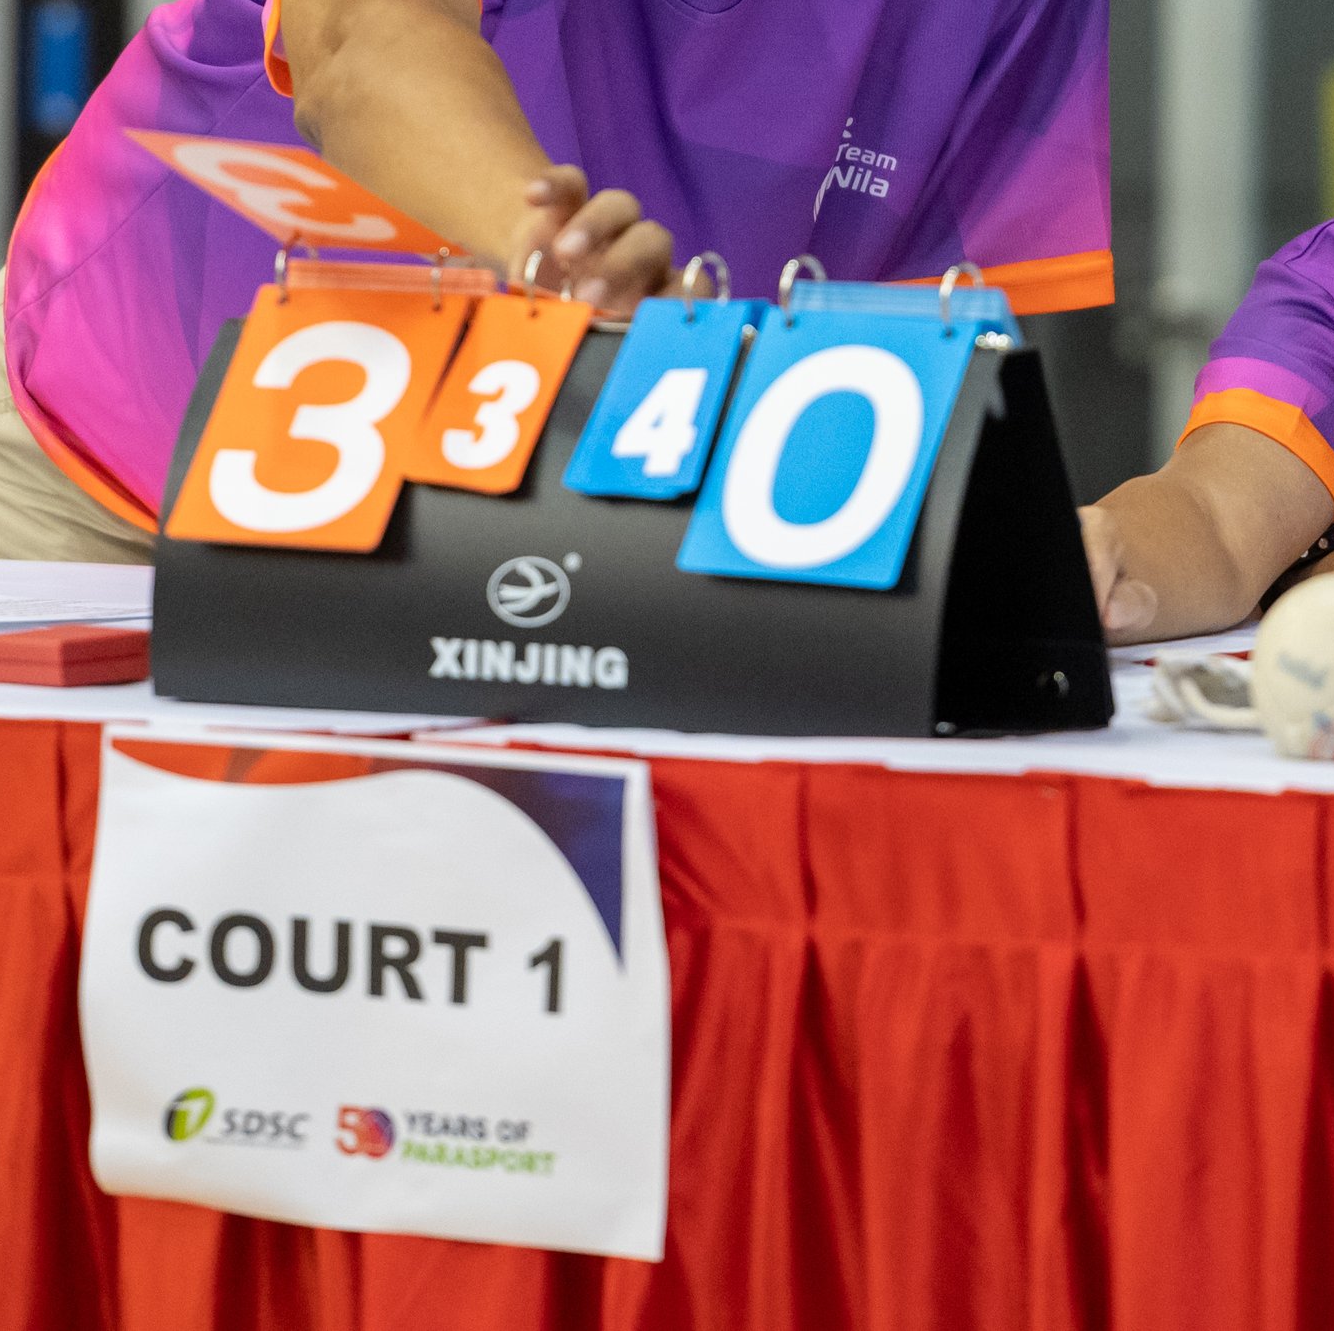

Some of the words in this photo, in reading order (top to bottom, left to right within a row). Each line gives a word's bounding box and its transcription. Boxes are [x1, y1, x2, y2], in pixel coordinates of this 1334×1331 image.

[835, 143, 897, 171] Team
[826, 165, 889, 198] Nila
[209, 320, 412, 534] 3
[441, 359, 541, 470] 3
[611, 366, 708, 478] 4
[721, 343, 925, 571] 0
[428, 636, 630, 690] XINJING
[136, 906, 489, 1006] COURT
[527, 935, 564, 1014] 1
[221, 1108, 310, 1140] SDSC
[404, 1110, 488, 1141] YEARS
[496, 1118, 531, 1144] OF
[401, 1140, 556, 1176] PARASPORT
